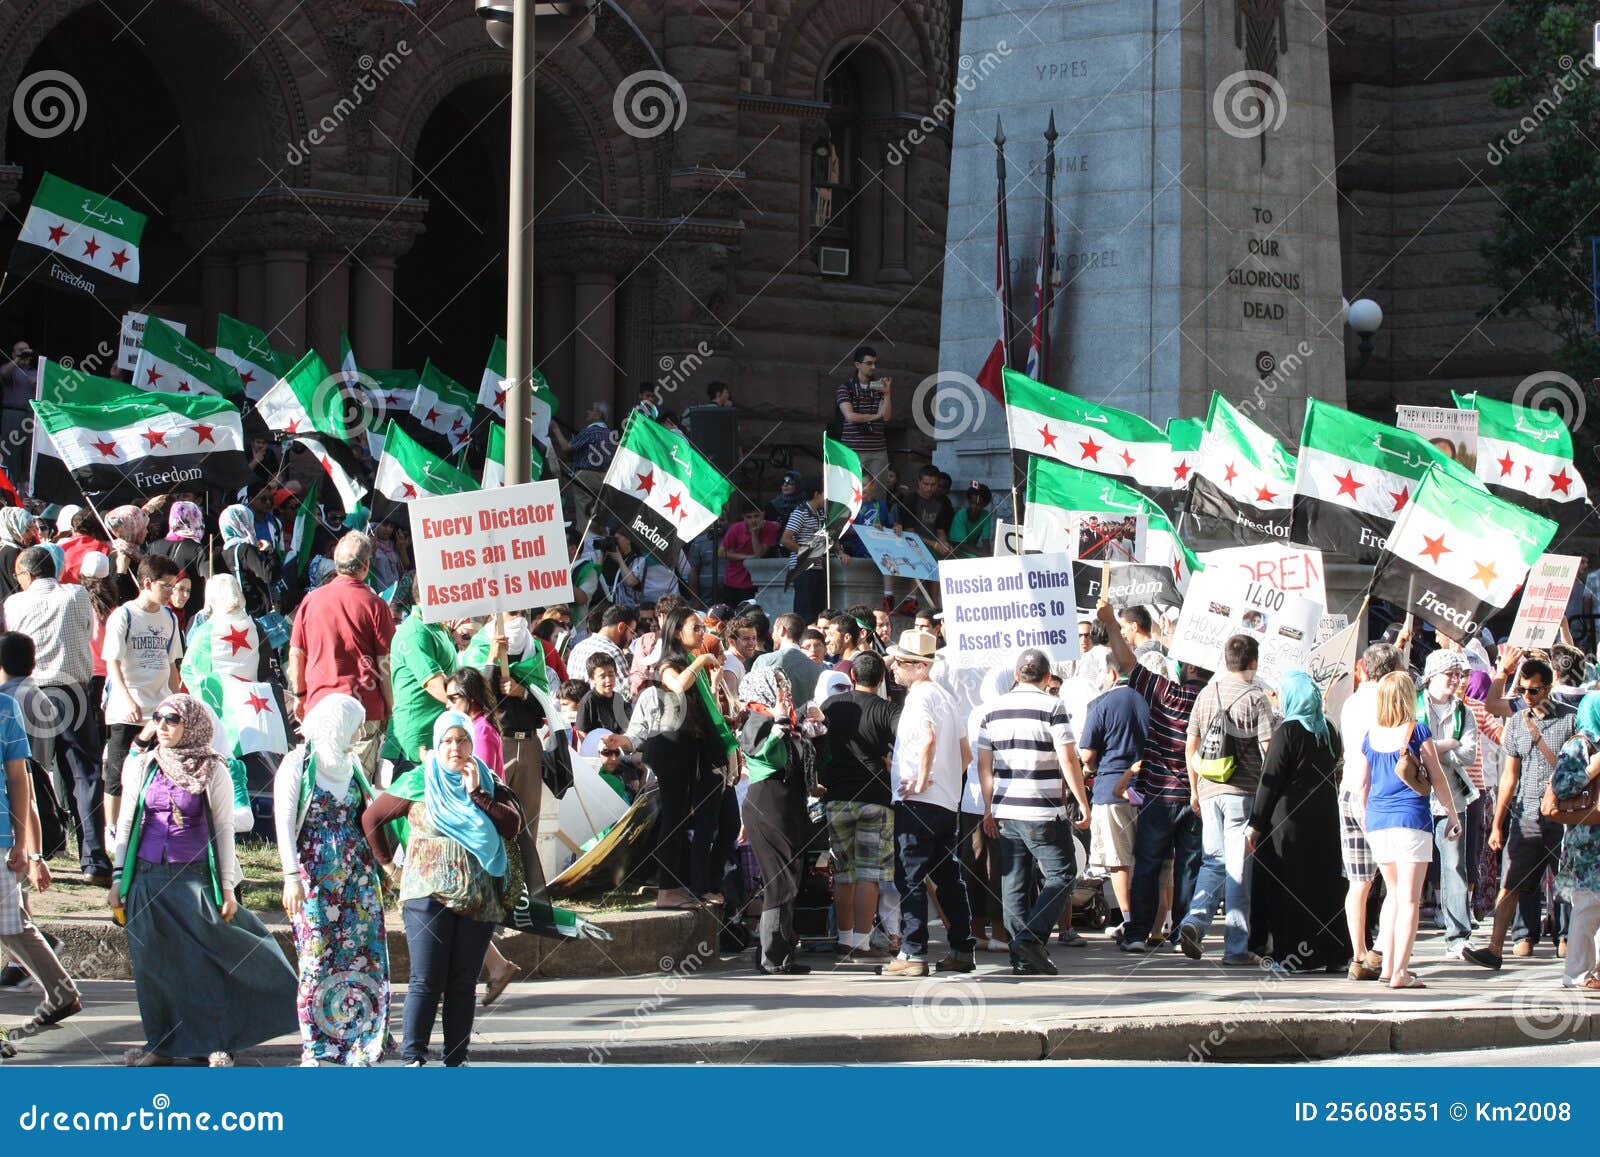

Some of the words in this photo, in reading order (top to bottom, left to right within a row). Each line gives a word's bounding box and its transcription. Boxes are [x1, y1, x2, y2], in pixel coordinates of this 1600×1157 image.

[1036, 60, 1088, 80] YPRES
[1252, 207, 1272, 224] TO
[1248, 238, 1279, 256] OUR
[50, 263, 95, 294] Freedom
[1228, 268, 1300, 290] GLORIOUS
[1243, 301, 1284, 320] DEAD
[1403, 410, 1420, 422] THEY
[1422, 411, 1444, 423] KILLED
[1447, 412, 1458, 424] HIM
[135, 464, 202, 488] Freedom
[422, 515, 473, 539] Every
[479, 503, 555, 531] Dictator
[441, 549, 476, 570] has
[483, 544, 506, 564] an
[511, 536, 546, 560] End
[427, 578, 499, 606] Assad's
[505, 574, 522, 594] is
[528, 569, 568, 591] Now
[945, 575, 992, 595] Russia
[997, 573, 1024, 592] and
[1028, 571, 1069, 589] China
[1088, 578, 1163, 597] Feedom
[1546, 583, 1570, 599] Freedom
[1245, 583, 1285, 612] 1400
[955, 602, 1047, 623] Accomplices
[1050, 600, 1065, 617] to
[1416, 590, 1479, 634] Freedo
[131, 637, 168, 649] TIMBERL
[959, 631, 1012, 651] Assad's
[1016, 629, 1067, 647] Crimes
[1184, 631, 1223, 650] CHILDRE
